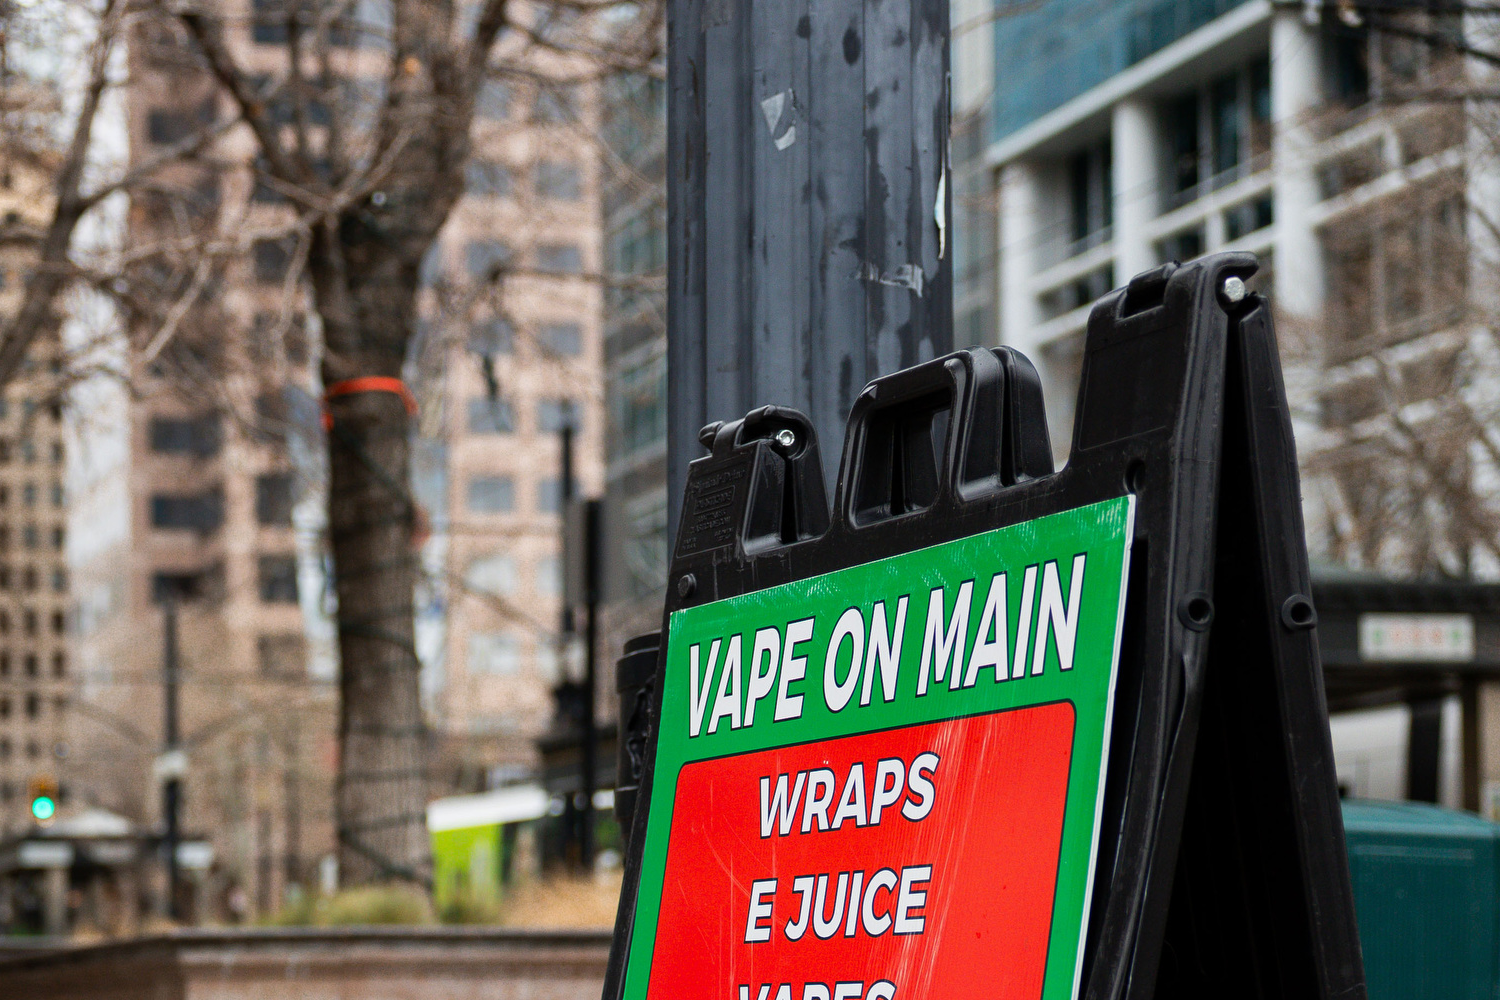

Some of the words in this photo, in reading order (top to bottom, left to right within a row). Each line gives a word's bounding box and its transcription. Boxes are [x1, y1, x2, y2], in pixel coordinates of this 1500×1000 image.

[688, 617, 816, 738] VAPE
[822, 595, 910, 713] ON
[915, 553, 1087, 697] MAIN
[759, 752, 941, 838] WRAPS
[743, 878, 779, 943] E
[783, 865, 933, 940] JUICE
